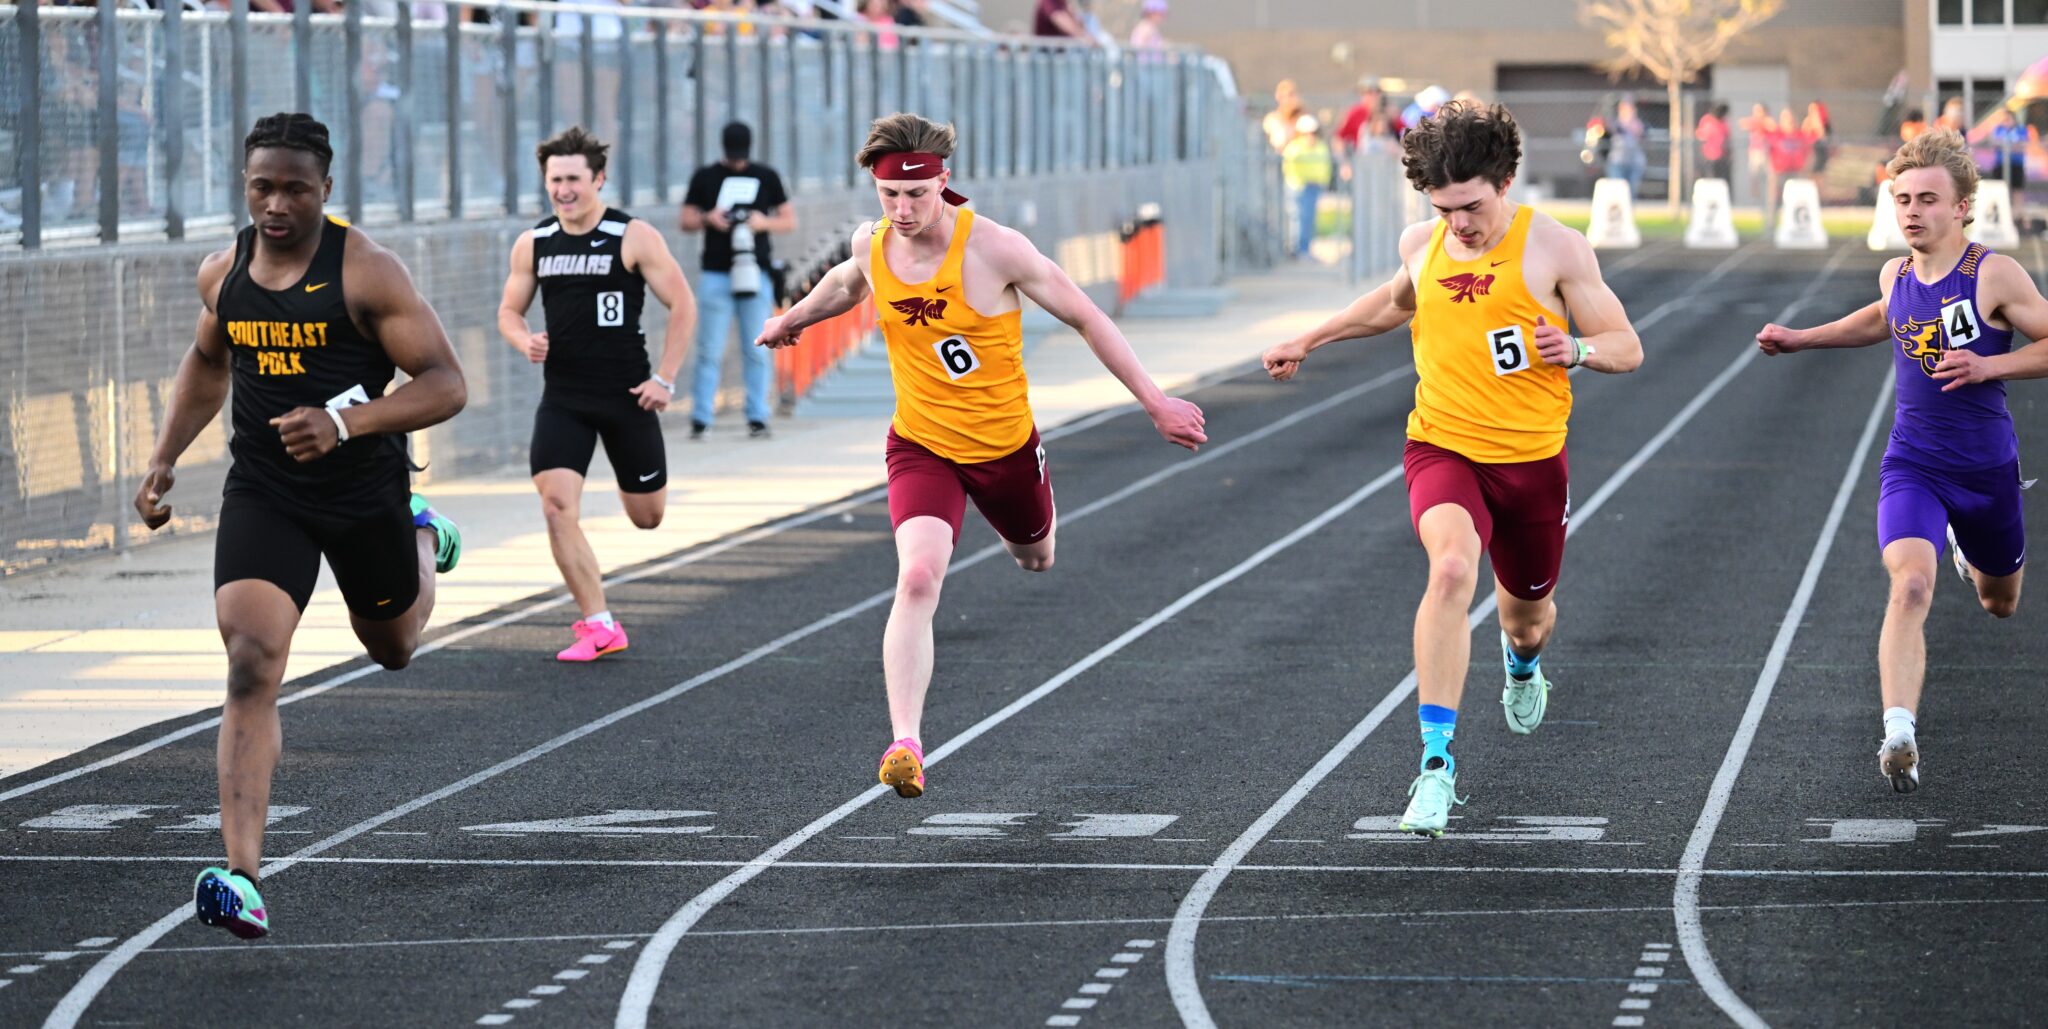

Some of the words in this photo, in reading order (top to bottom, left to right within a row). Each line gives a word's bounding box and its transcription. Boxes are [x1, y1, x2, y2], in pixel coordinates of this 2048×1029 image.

[603, 294, 618, 321] 8
[1951, 304, 1974, 340] 4
[227, 320, 328, 347] SOUTHEAST
[257, 351, 306, 375] POLK
[941, 339, 972, 374] 6
[1493, 329, 1521, 370] 5
